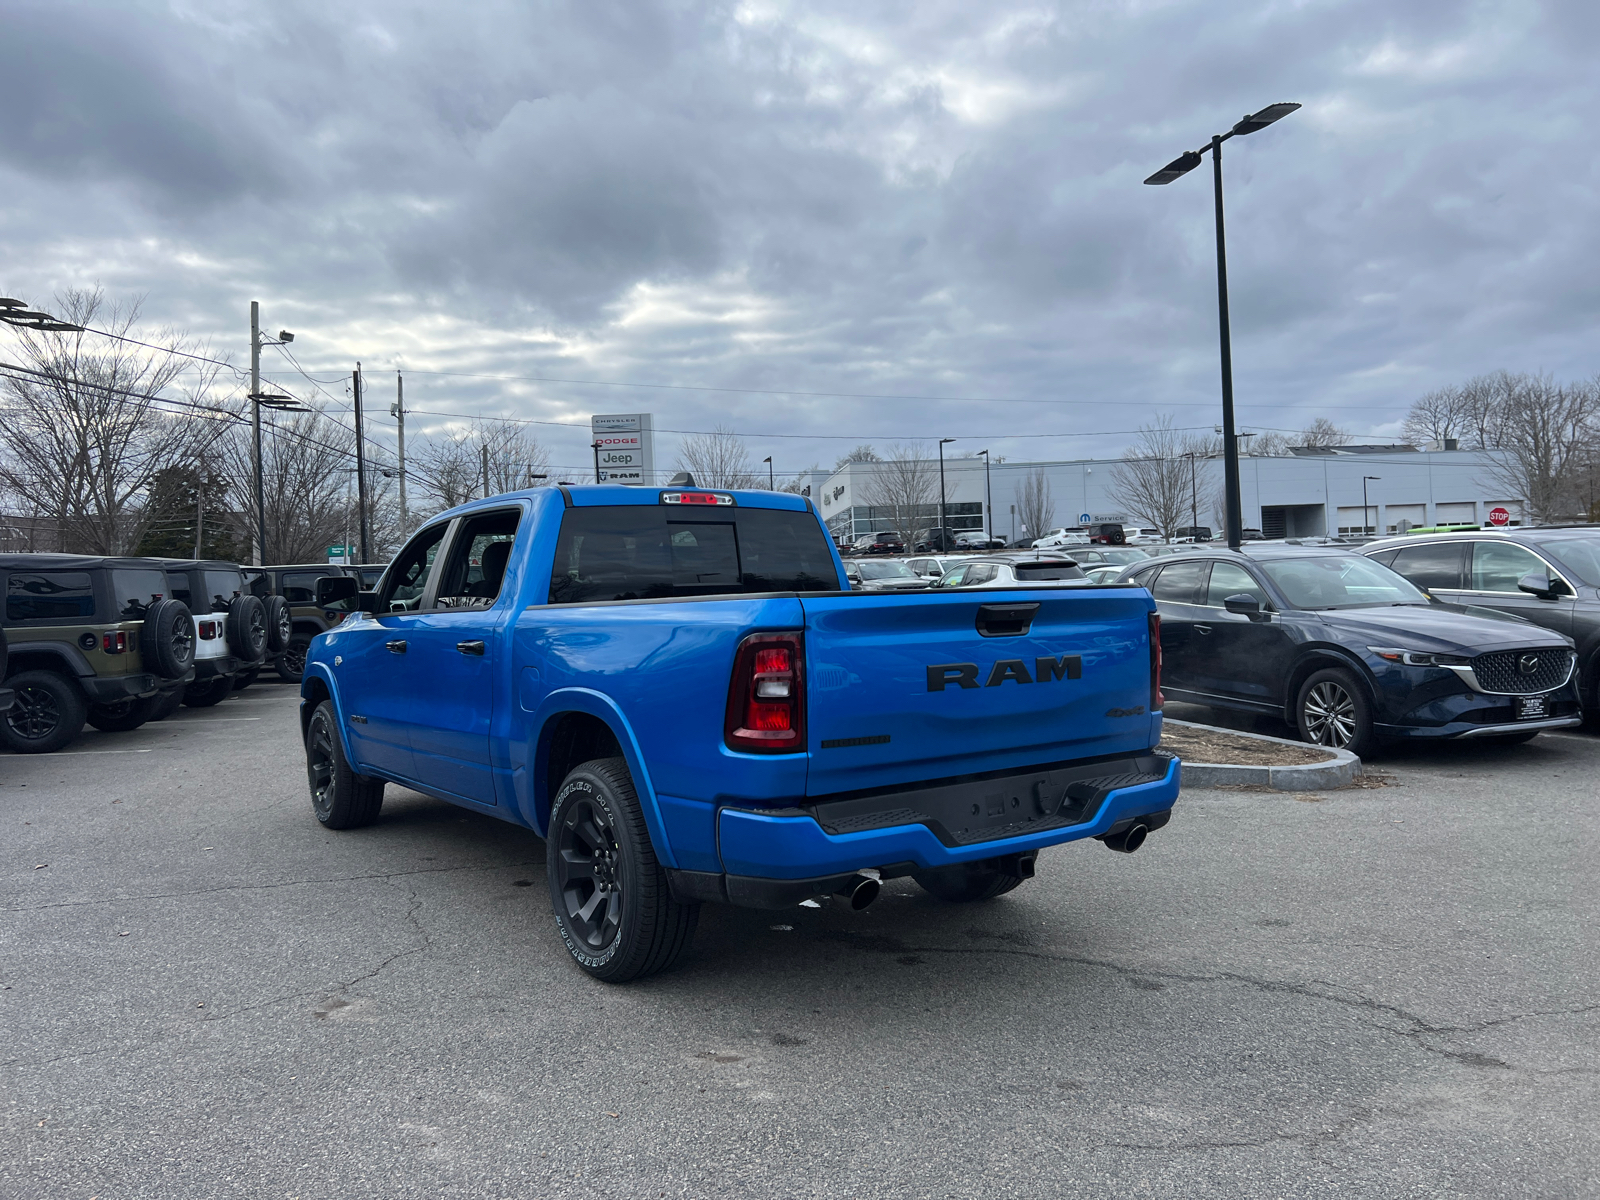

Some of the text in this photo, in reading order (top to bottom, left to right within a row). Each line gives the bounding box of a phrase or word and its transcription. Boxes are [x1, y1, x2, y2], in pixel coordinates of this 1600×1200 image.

[603, 452, 632, 464] Jeep
[1490, 512, 1509, 520] STOP
[927, 654, 1082, 692] RAM
